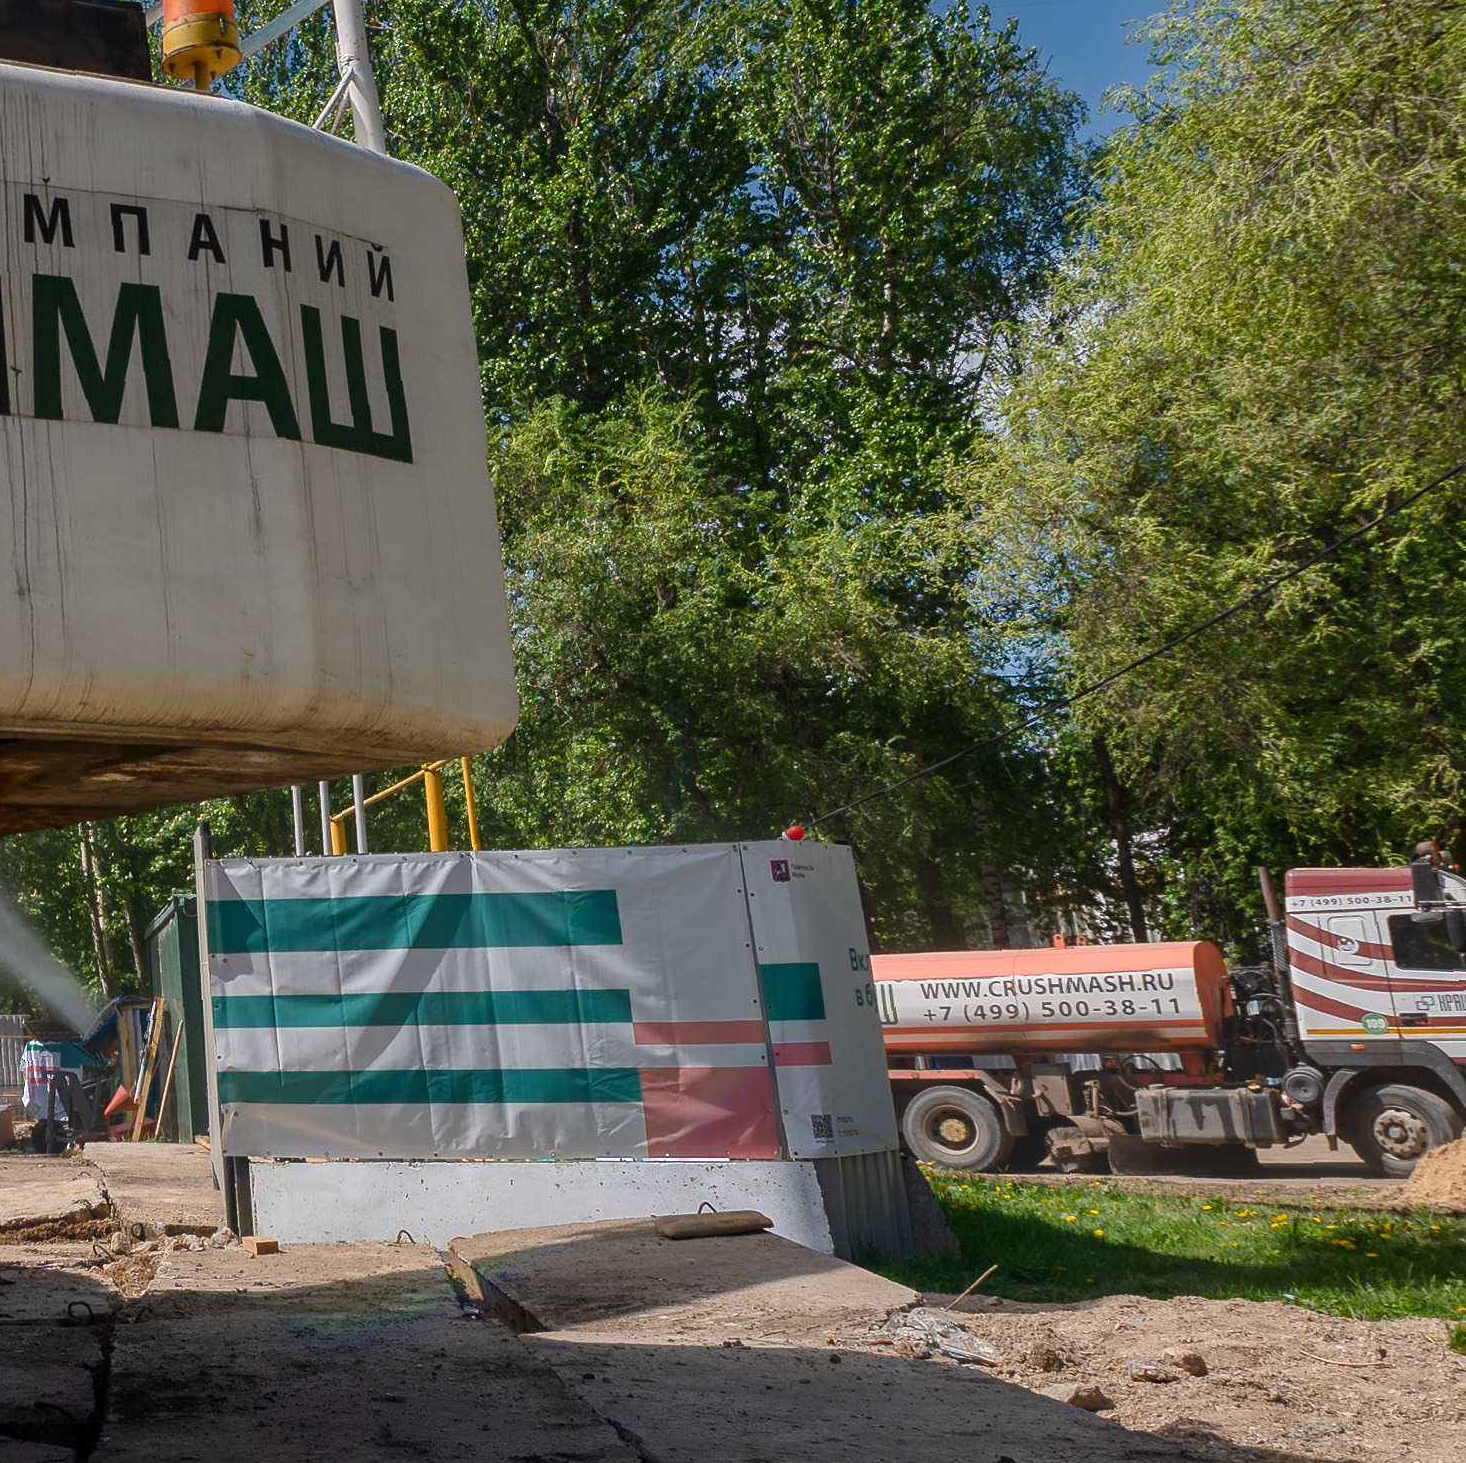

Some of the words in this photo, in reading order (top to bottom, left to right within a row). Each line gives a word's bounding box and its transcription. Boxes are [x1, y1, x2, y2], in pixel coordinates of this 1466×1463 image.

[1310, 897, 1343, 907] (499)
[1347, 894, 1413, 905] 500-38-11
[919, 972, 1174, 1000] WWW.CRUSHMASH.RU
[923, 1005, 952, 1022] +7
[963, 1001, 1031, 1022] (499)
[1041, 997, 1181, 1018] 500-38-11
[1364, 1017, 1386, 1029] 109
